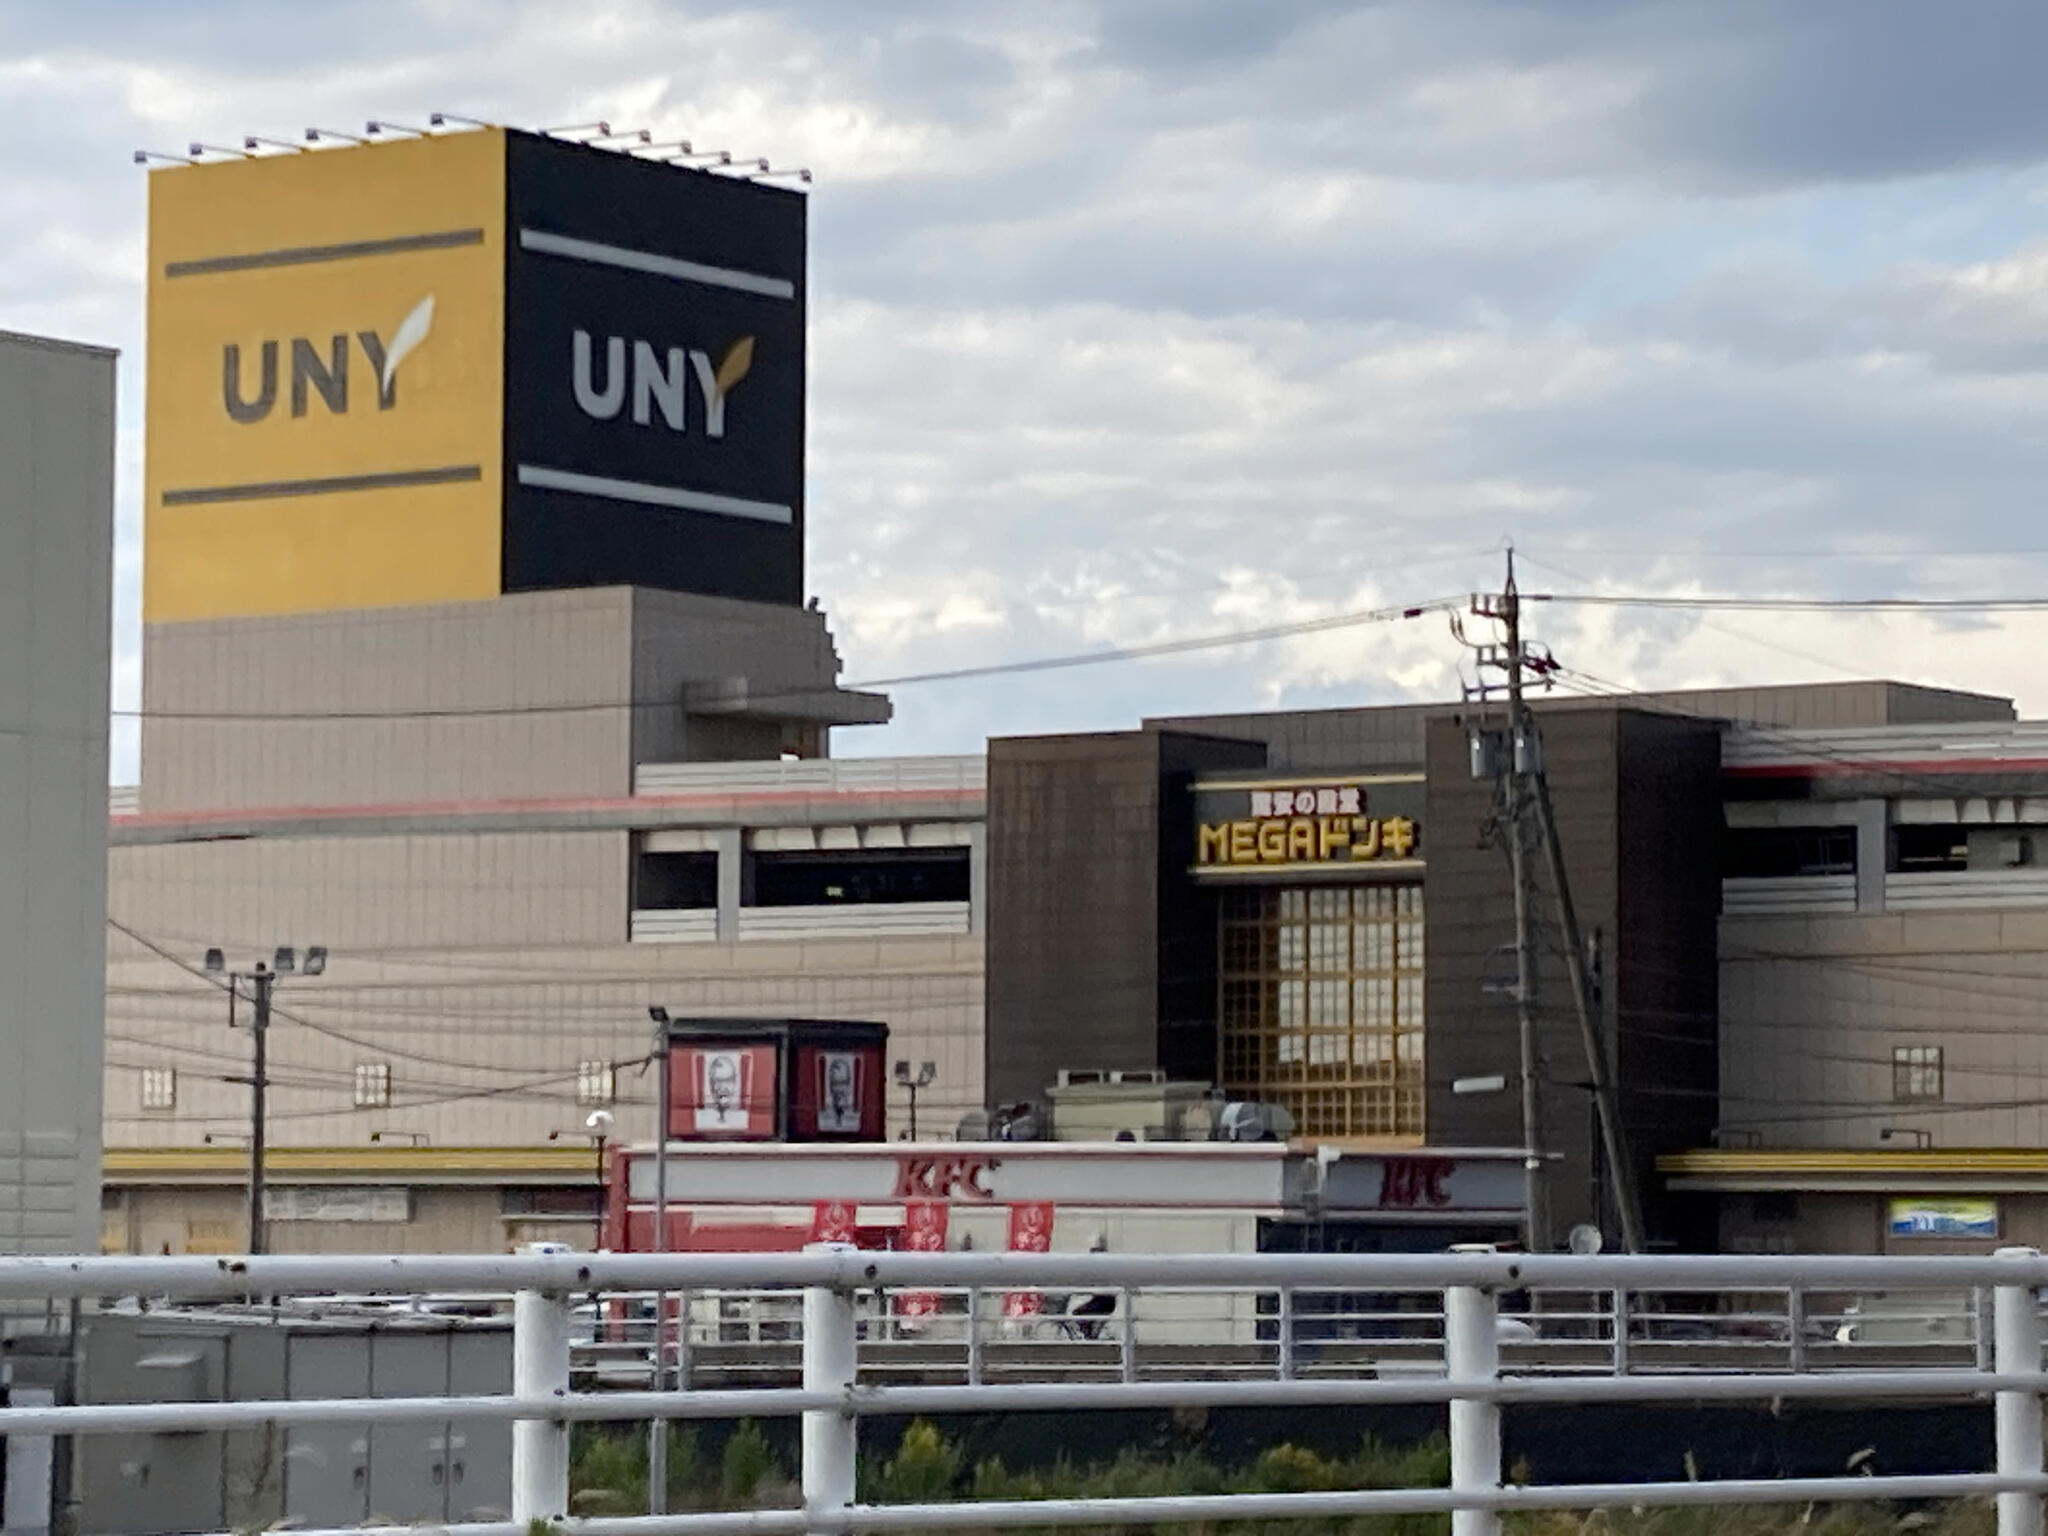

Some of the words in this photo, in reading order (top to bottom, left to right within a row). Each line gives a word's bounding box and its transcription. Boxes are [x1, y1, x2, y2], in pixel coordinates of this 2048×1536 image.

[222, 294, 434, 425] UNY
[573, 328, 756, 438] UNY
[1201, 816, 1413, 863] MEGAドンキ
[895, 1158, 1000, 1200] KFC
